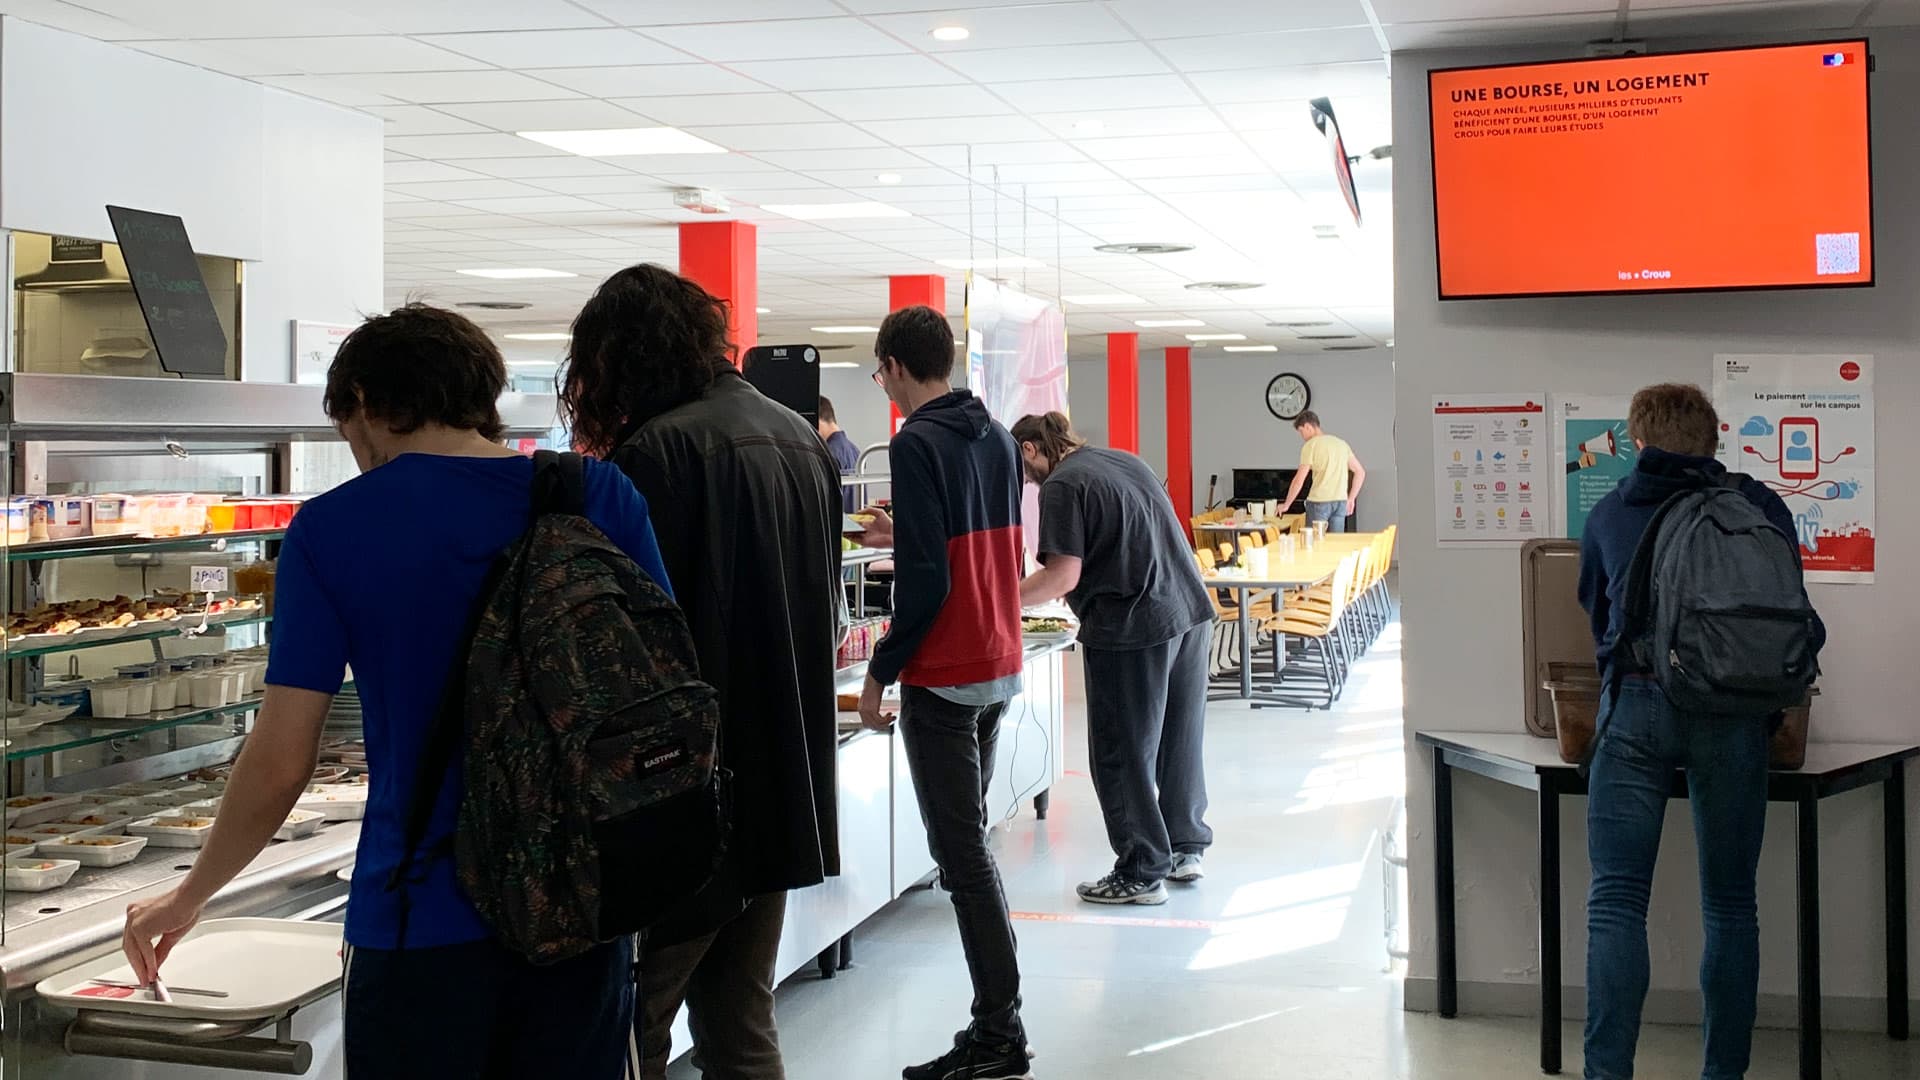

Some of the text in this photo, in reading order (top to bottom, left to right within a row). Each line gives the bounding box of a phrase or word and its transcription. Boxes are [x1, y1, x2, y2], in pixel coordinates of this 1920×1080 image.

[1452, 72, 1710, 102] UNE BOURSE, UN LOGEMENT
[1453, 95, 1683, 118] CHAQUE ANNÉE, PLUSIEURS MILLIERS D'ÉTUDIANTS
[1454, 108, 1660, 128] BÉNÉFICIENT D'UNE BOURSE, D'UN LOGEMENT
[1454, 122, 1604, 139] CROUS POUR FAIRE LEURS ÉTUDES
[1641, 269, 1672, 280] Crous
[1754, 392, 1765, 401] Le
[1766, 392, 1806, 402] paiement
[1814, 401, 1827, 409] les
[1828, 402, 1861, 411] campus
[644, 750, 680, 768] EASTPAK
